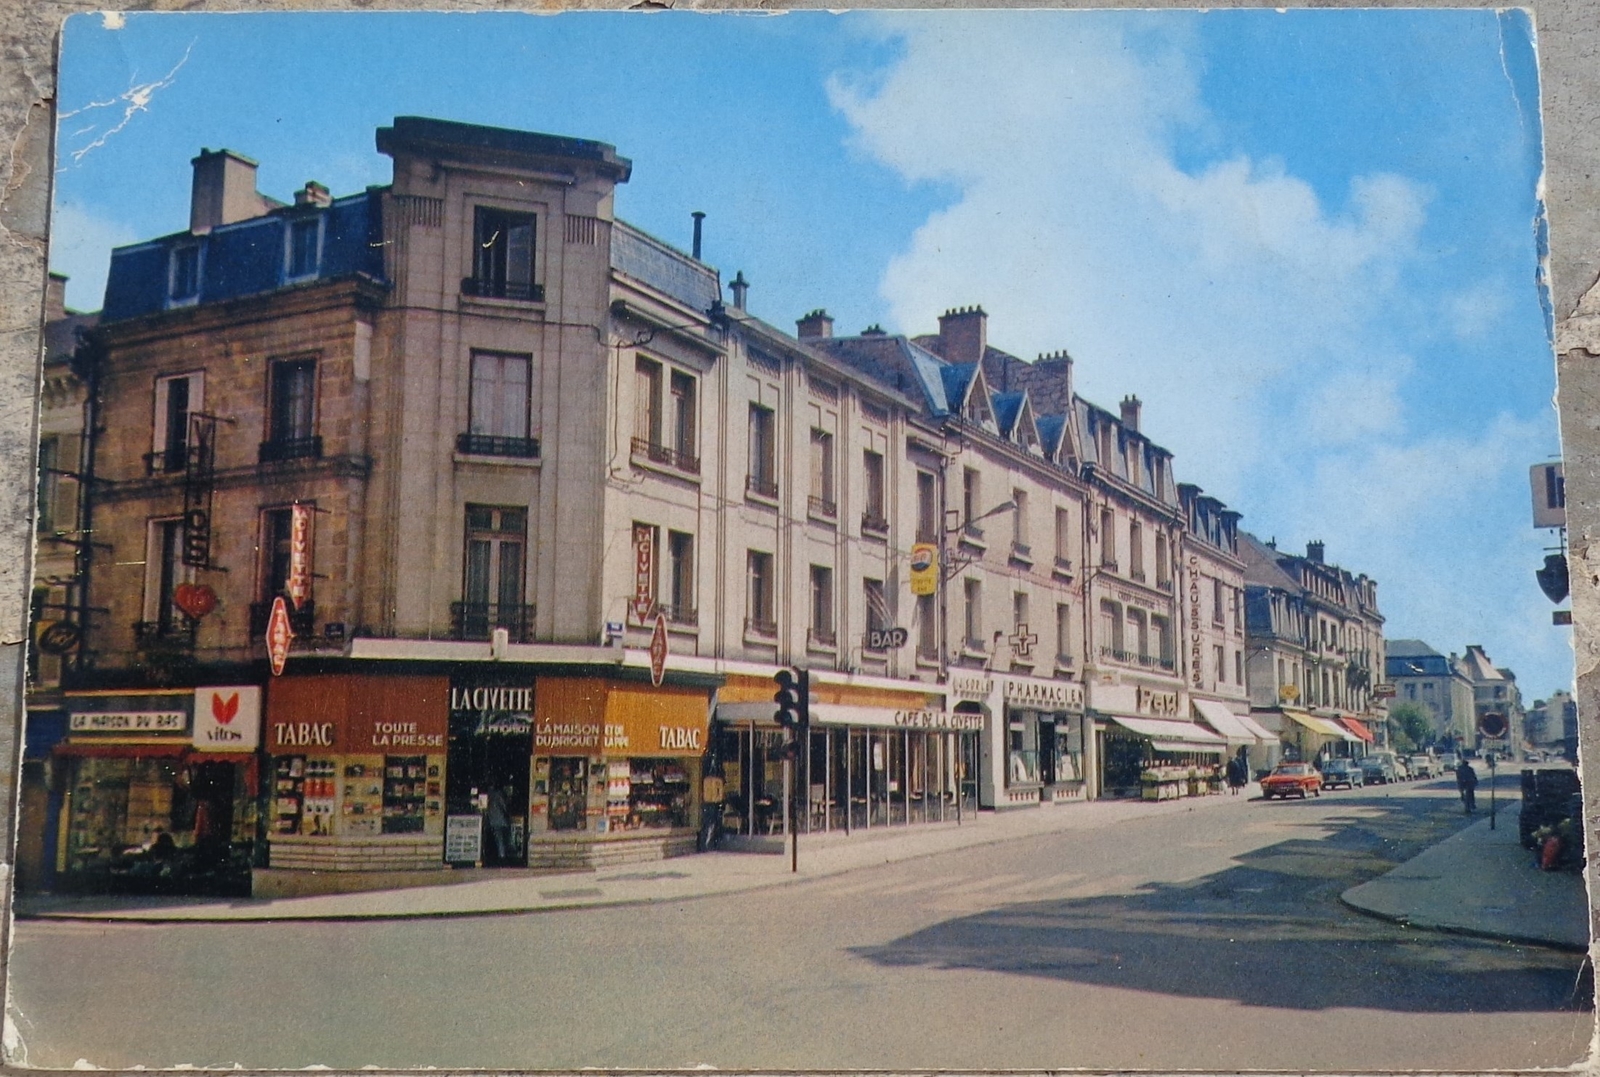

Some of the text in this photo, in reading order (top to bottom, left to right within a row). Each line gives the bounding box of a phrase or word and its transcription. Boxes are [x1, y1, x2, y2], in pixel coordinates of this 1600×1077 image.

[639, 542, 649, 613] CIVETTE
[1190, 556, 1201, 682] CHAUSSURES
[871, 631, 904, 648] BAR
[452, 687, 533, 711] LA CIVETTE
[1008, 681, 1084, 702] PHARMACIEN
[136, 715, 151, 727] DU
[375, 722, 417, 734] TOUTE
[922, 713, 932, 728] DE
[936, 714, 947, 728] LA
[950, 714, 984, 729] CIVETTE
[275, 722, 333, 747] TABAC
[536, 724, 550, 735] LA
[553, 724, 599, 736] MAISON
[659, 726, 700, 749] TABAC
[372, 735, 443, 747] LA PRESSE
[536, 735, 599, 747] DU BRIQUET
